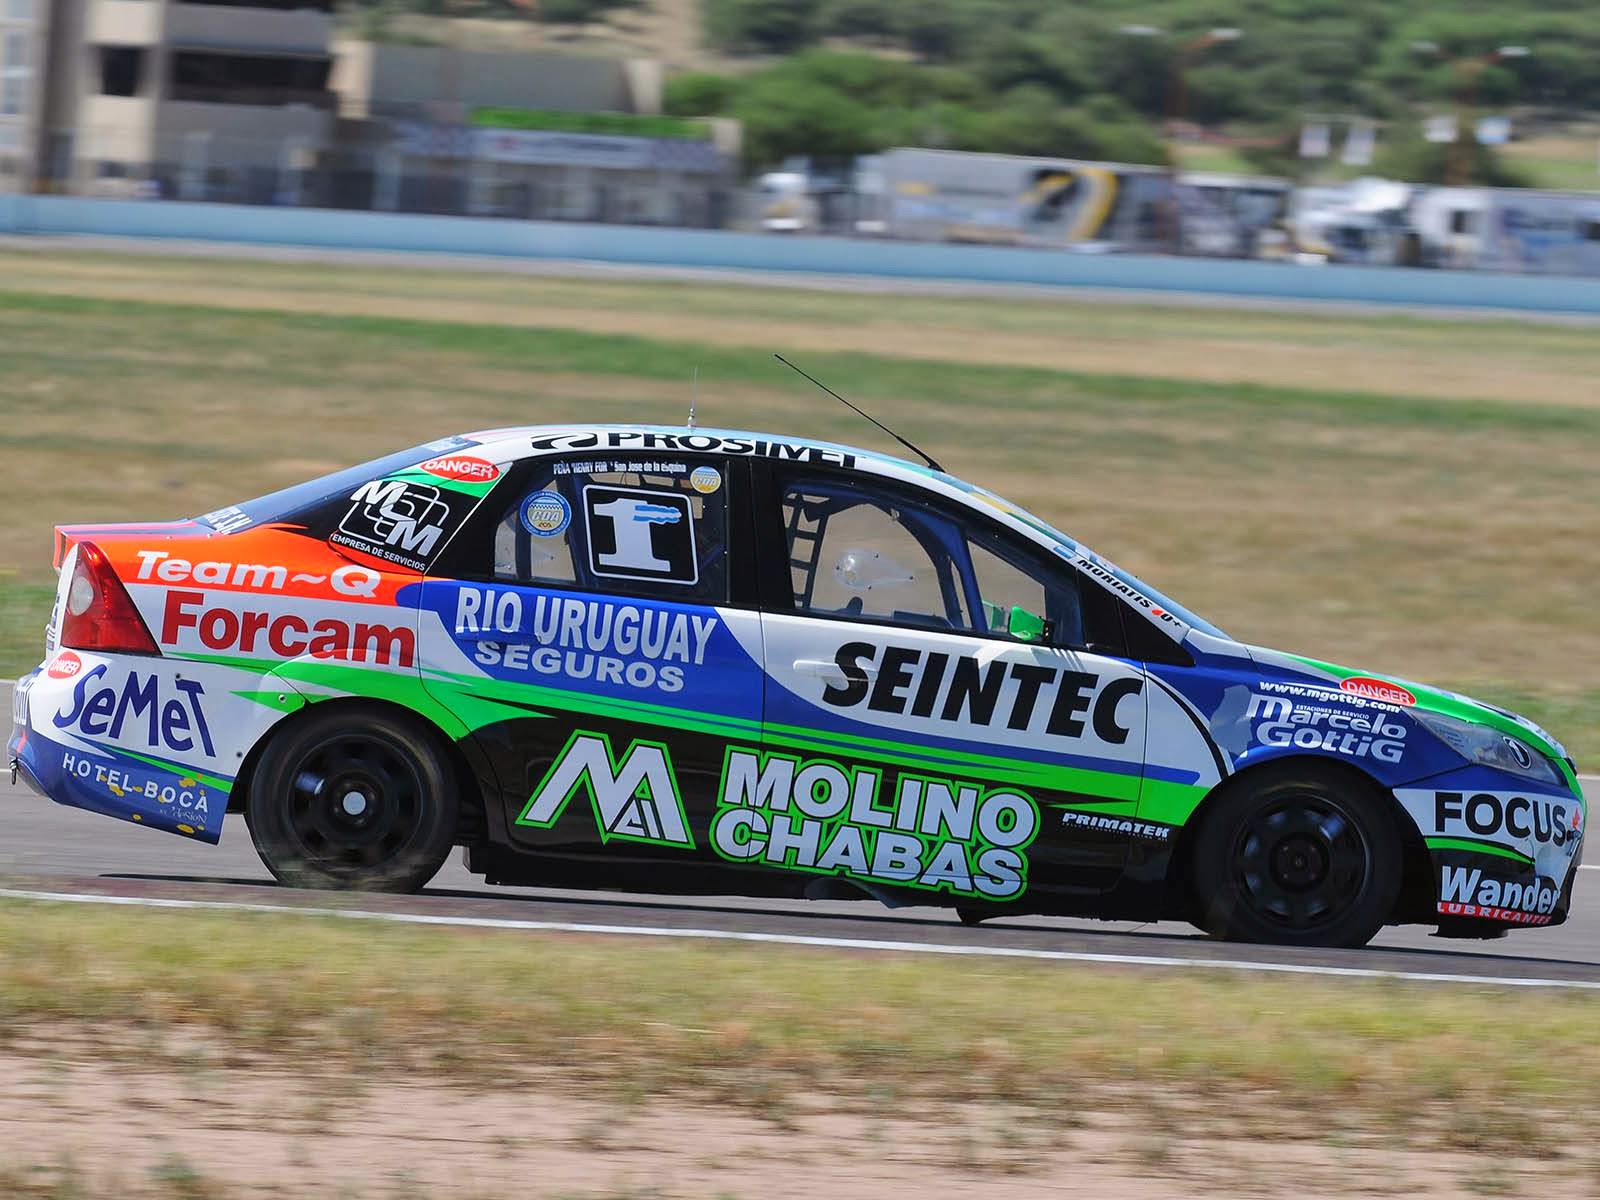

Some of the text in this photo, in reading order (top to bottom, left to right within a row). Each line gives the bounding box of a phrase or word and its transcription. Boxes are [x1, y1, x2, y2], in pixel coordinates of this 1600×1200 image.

[424, 459, 494, 479] DANGER
[332, 533, 426, 571] EMPRESA DE SERVICIOS
[593, 497, 671, 573] 1
[1077, 559, 1152, 608] MORIATIS
[161, 590, 415, 668] Forcam
[455, 586, 718, 665] RIO URUGUAY
[475, 639, 685, 692] SEGUROS
[822, 642, 1145, 745] SEINTEC
[1259, 681, 1402, 714] www.mgottig.com
[1295, 704, 1333, 715] ESTACIONES
[1341, 710, 1370, 720] SERVICIO
[1346, 681, 1411, 704] DANGER
[62, 752, 208, 813] HOTEL BOCA
[722, 750, 1037, 849] MOLINO
[1062, 812, 1170, 838] PRIMATEK
[1435, 791, 1566, 847] FOCUS
[715, 811, 1022, 897] CHABAS
[1441, 865, 1561, 914] Wander
